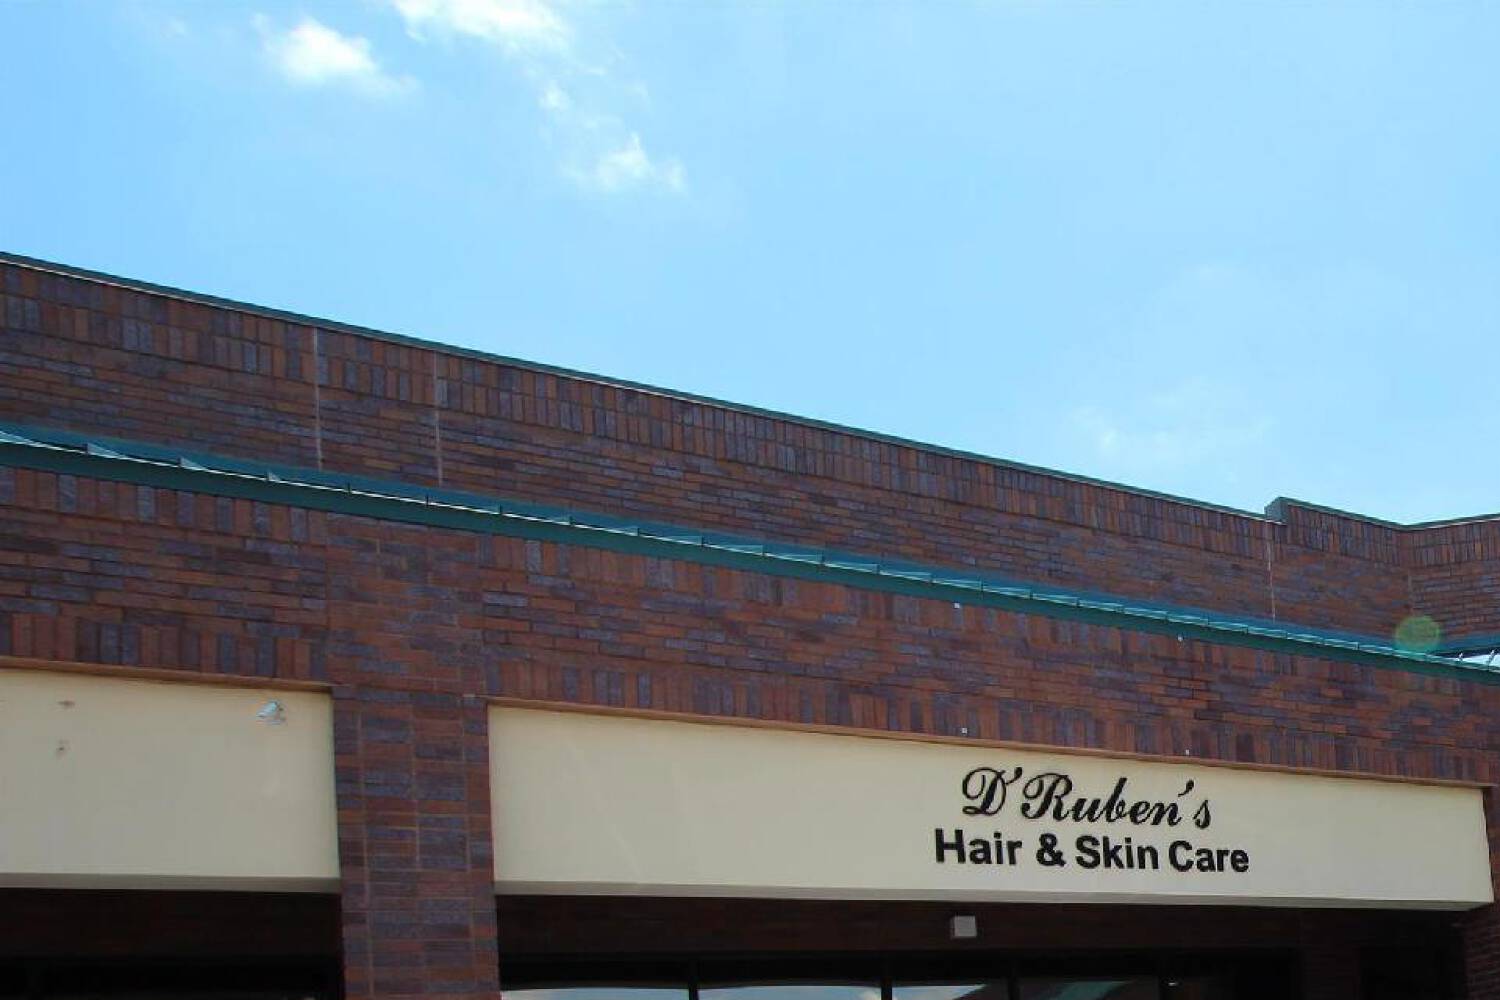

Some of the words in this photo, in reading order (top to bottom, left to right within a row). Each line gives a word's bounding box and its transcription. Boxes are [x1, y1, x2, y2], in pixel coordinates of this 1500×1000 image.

[961, 766, 1212, 829] D'Ruben's
[934, 828, 1022, 865] Hair
[1036, 833, 1066, 867] &
[1075, 835, 1159, 869] Skin
[1168, 840, 1249, 872] Care
